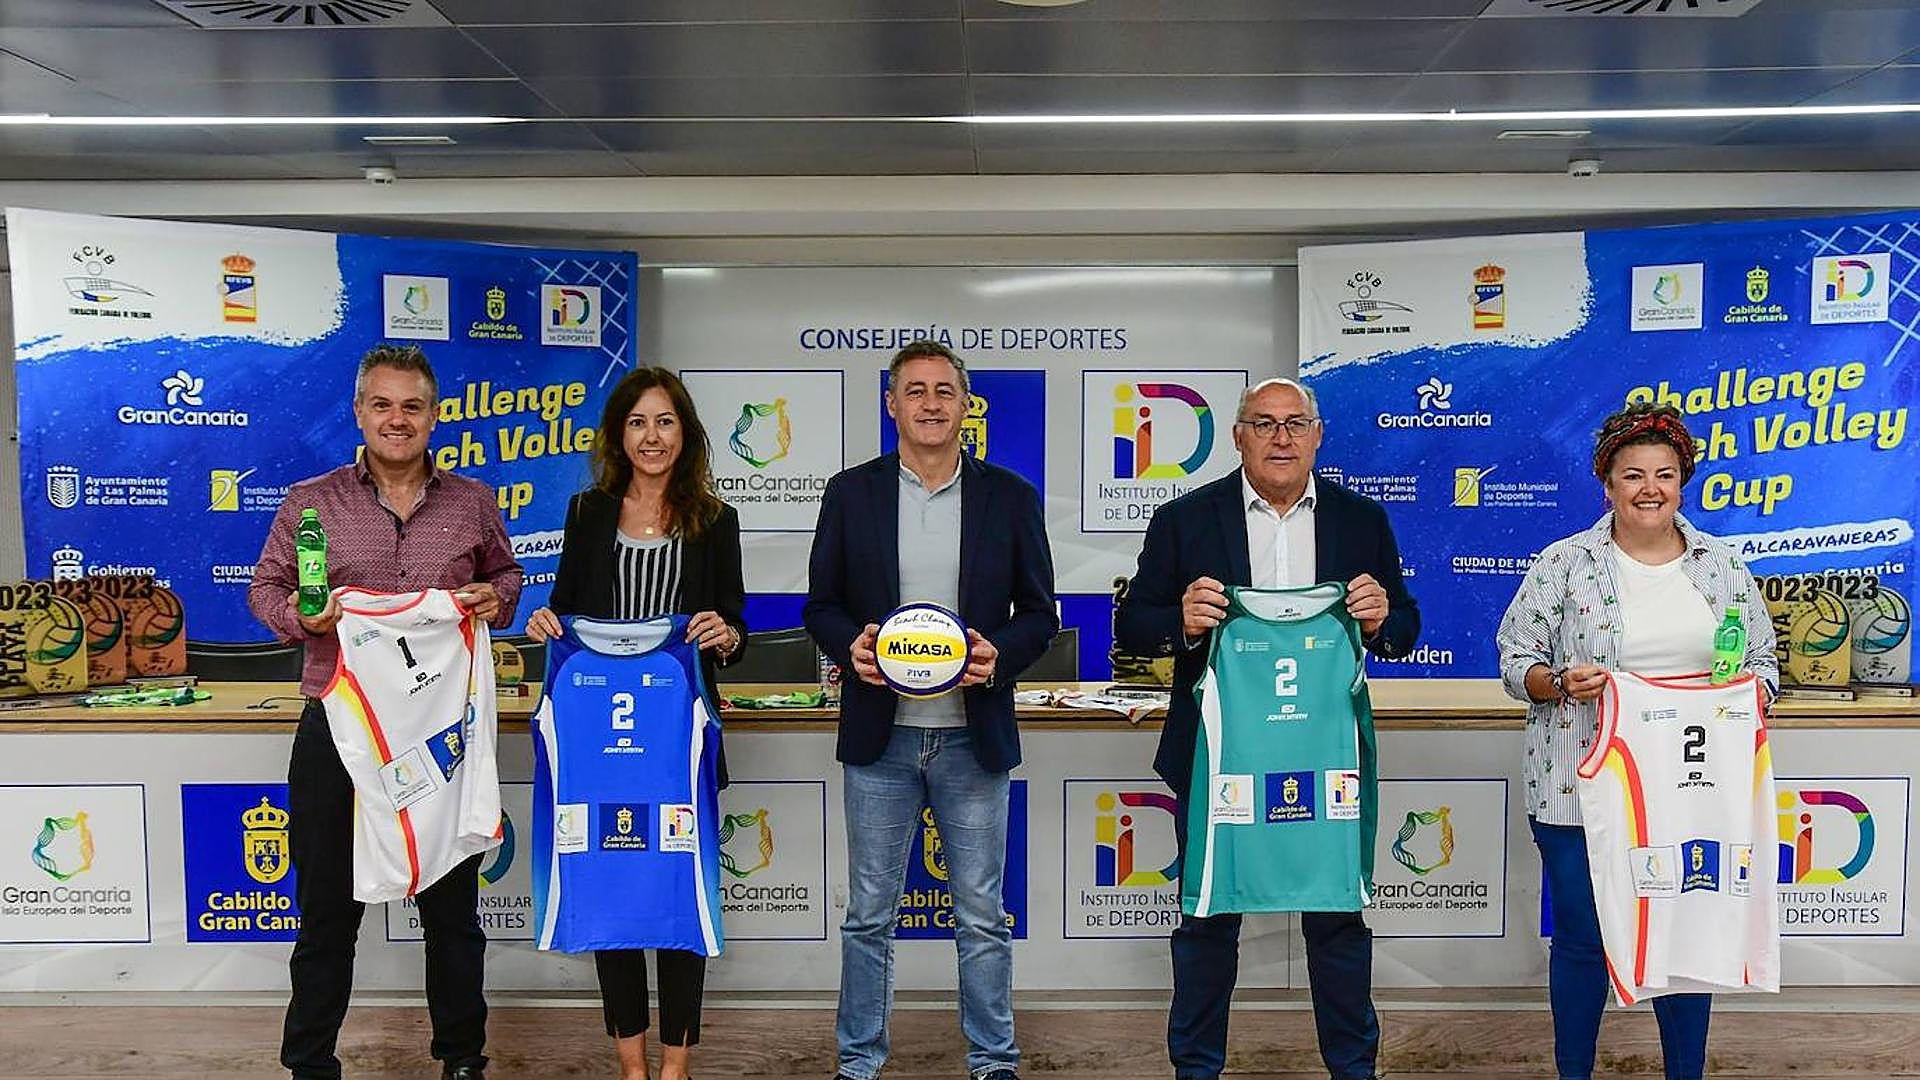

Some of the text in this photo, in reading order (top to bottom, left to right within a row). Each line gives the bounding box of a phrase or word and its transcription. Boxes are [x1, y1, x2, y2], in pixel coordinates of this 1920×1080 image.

[73, 246, 115, 264] FCVB
[1347, 272, 1382, 288] FCVB
[1729, 304, 1782, 314] Cabildo de
[1724, 313, 1788, 323] Gran Canaria
[472, 321, 505, 331] Cabildo
[469, 330, 523, 340] Gran Canaria
[962, 328, 993, 350] DE
[1001, 328, 1128, 350] DEPORTES
[438, 381, 586, 421] allenge
[1754, 403, 1908, 454] Volley
[499, 418, 595, 461] Volle
[85, 476, 168, 487] Ayuntamiento
[716, 478, 746, 490] ran
[1347, 475, 1417, 485] Ayuntamiento
[1518, 483, 1558, 492] Municipal
[85, 487, 168, 496] de Las Palmas
[243, 487, 278, 495] Instituto
[1099, 484, 1167, 499] INSTITUTO
[1364, 484, 1379, 492] Las
[1383, 484, 1416, 492] Palmas
[1702, 473, 1793, 516] Cup
[85, 496, 168, 505] de Gran Canaria
[256, 496, 286, 506] Depor
[721, 493, 820, 503] uropea del Deport
[1383, 492, 1416, 501] Canaria
[1496, 492, 1534, 501] Deportes
[1104, 507, 1123, 520] DE
[1742, 528, 1898, 555] ALCARAVANERAS
[88, 564, 156, 576] Gobierno
[1452, 557, 1495, 567] CIUDAD
[1499, 558, 1514, 568] DE
[0, 583, 51, 611] 023
[397, 636, 418, 669] 1
[1275, 657, 1298, 697] 2
[612, 692, 635, 730] 2
[1684, 725, 1706, 763] 2
[3, 886, 131, 903] Gran Canaria
[730, 884, 808, 900] Canaria
[1410, 881, 1488, 898] Canaria
[1830, 887, 1887, 905] INSULAR
[208, 891, 291, 910] Cabildo
[480, 896, 533, 908] NSULAR
[899, 890, 954, 908] abild
[1081, 890, 1148, 906] INSTITUTO
[1380, 899, 1488, 910] Europea del Deporte
[23, 905, 67, 917] Europea
[70, 905, 86, 915] del
[89, 905, 132, 916] Deporte
[747, 902, 764, 912] del
[766, 902, 809, 914] Deporte
[199, 912, 251, 930] Gran
[1086, 910, 1181, 927] DE DEPORT
[1785, 907, 1880, 925] DEPORTES
